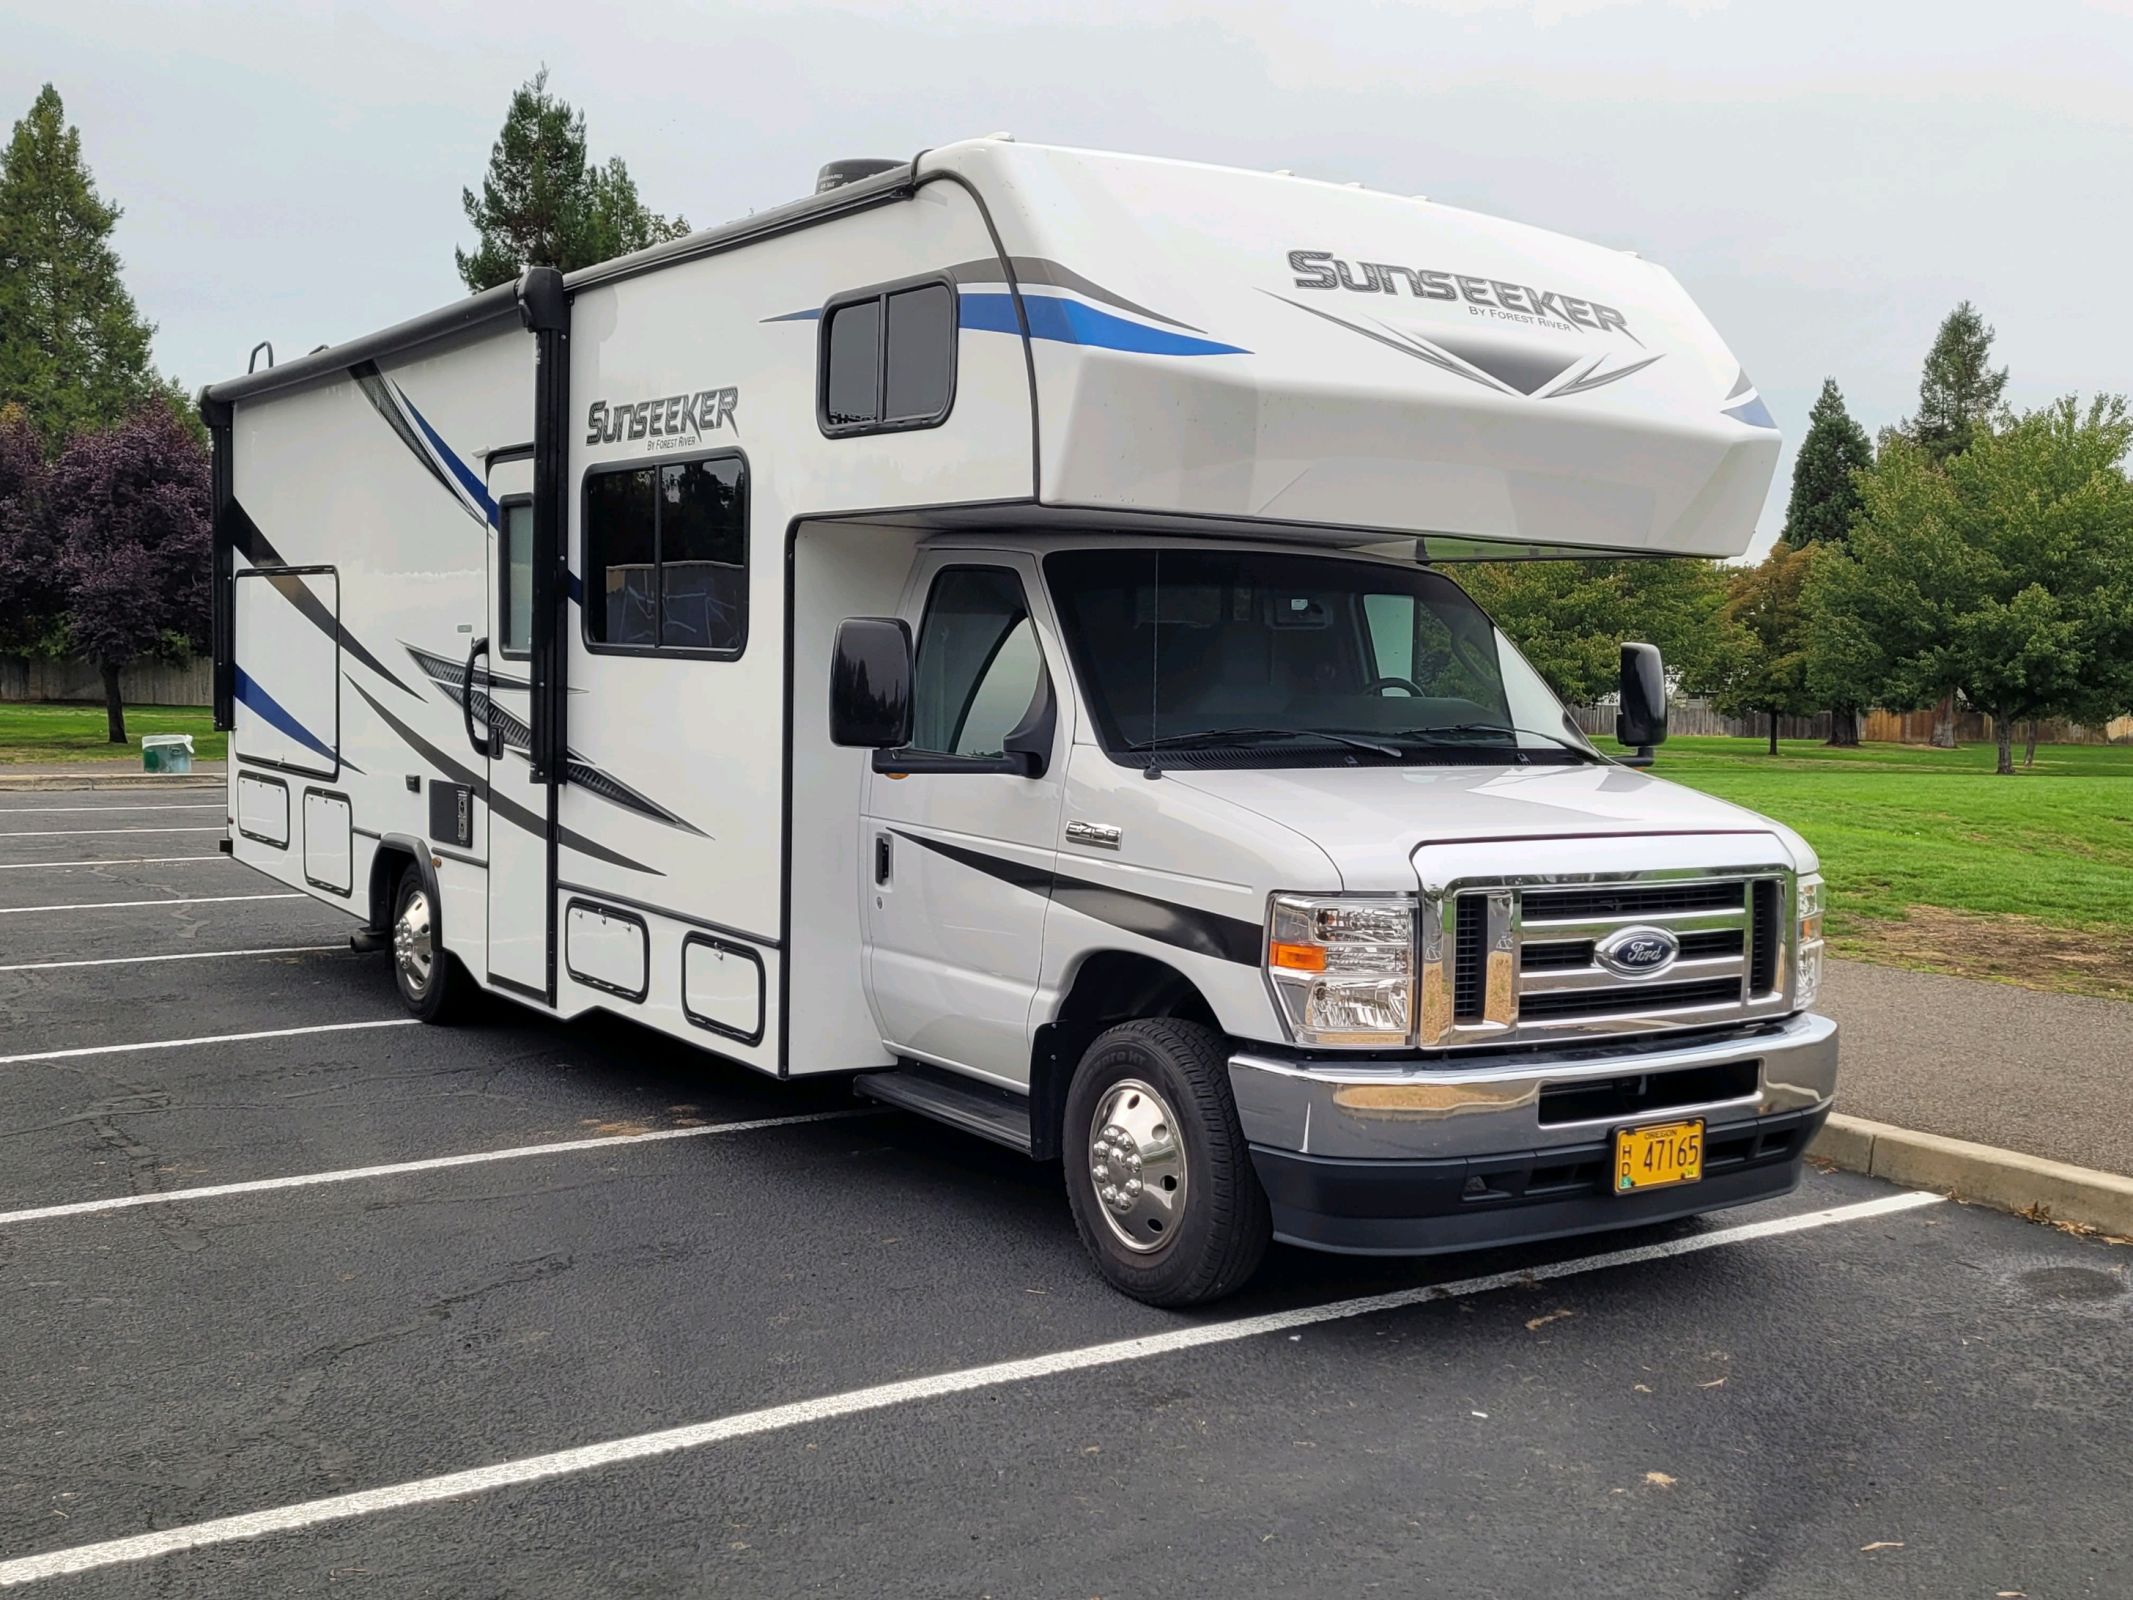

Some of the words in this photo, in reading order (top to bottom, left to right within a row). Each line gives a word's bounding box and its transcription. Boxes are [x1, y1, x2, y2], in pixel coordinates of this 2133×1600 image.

[1490, 309, 1535, 325] FOREST
[1538, 317, 1571, 332] RIVER
[656, 438, 677, 449] FOREST
[678, 436, 696, 447] RIVER
[1627, 941, 1663, 962] Ford
[1644, 1129, 1678, 1140] OREGON
[1643, 1134, 1700, 1173] 47165
